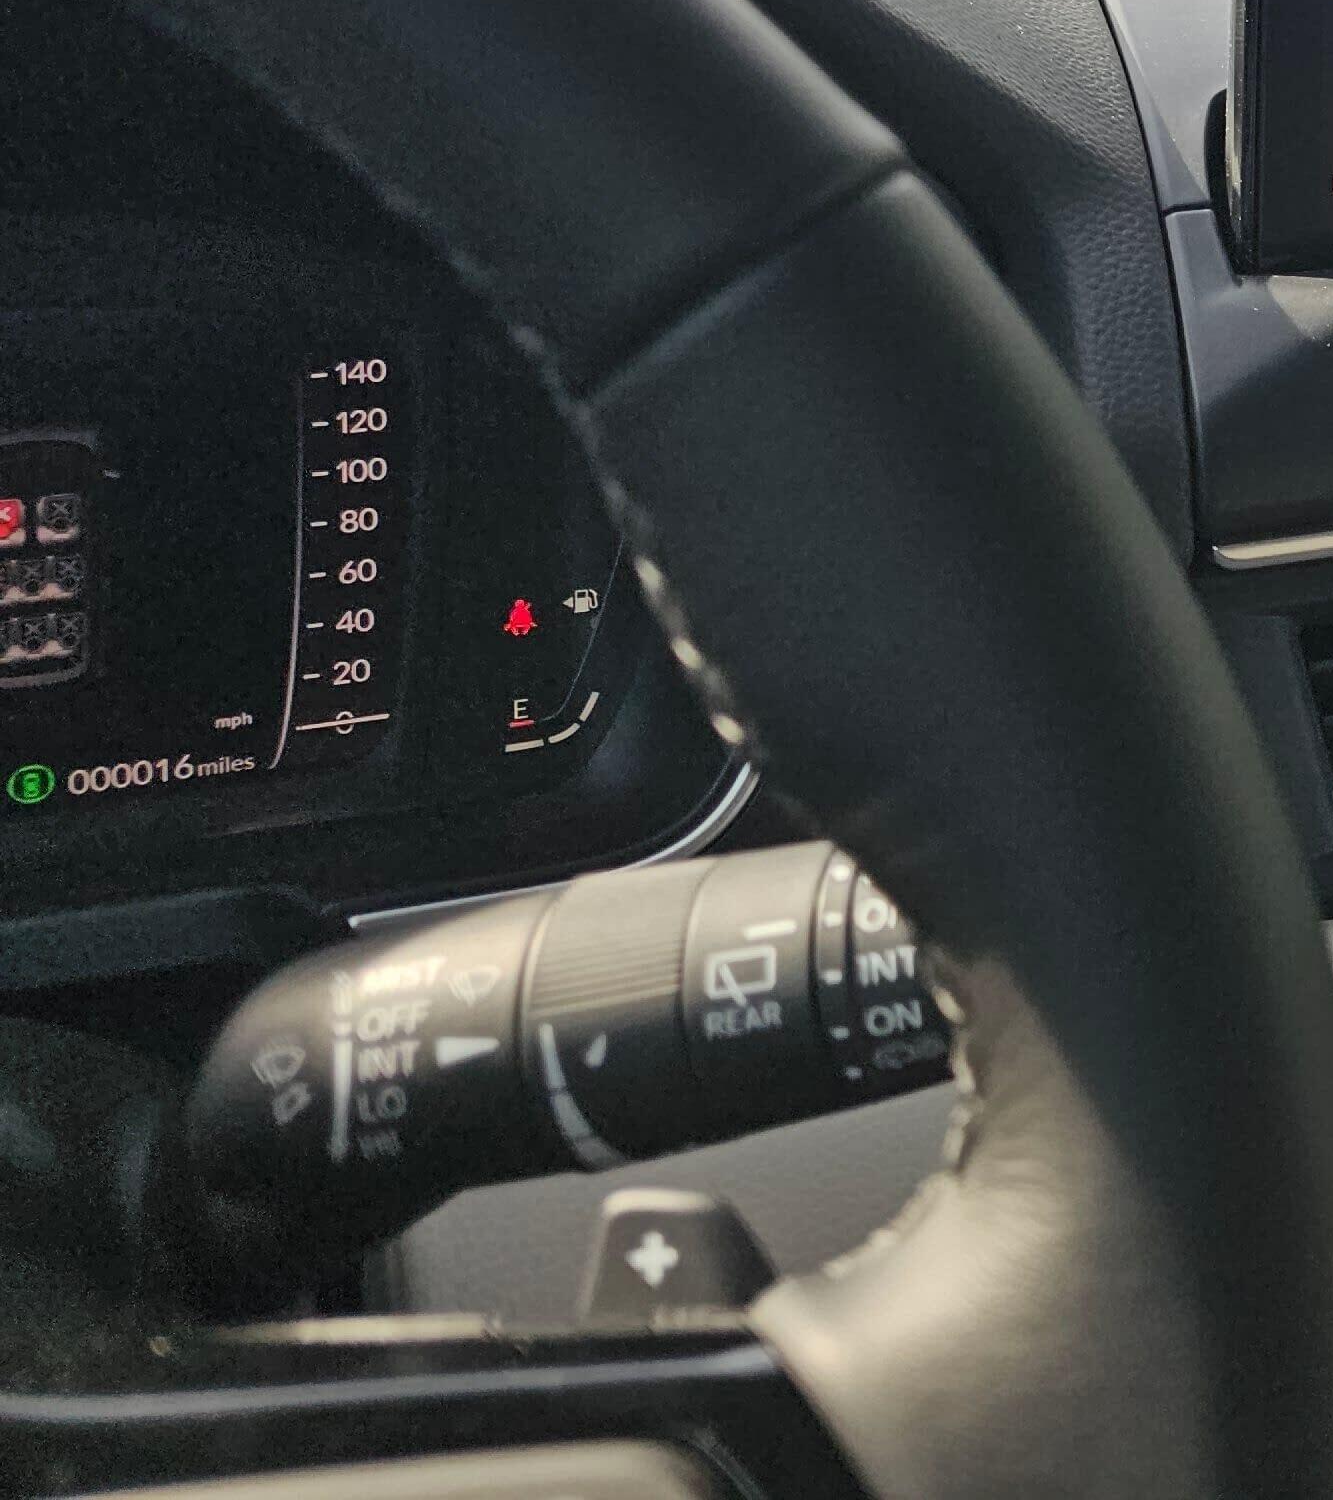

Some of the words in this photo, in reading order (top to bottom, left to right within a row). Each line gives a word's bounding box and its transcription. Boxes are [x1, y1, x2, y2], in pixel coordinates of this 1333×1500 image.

[334, 358, 387, 386] 140
[335, 407, 388, 434] 120
[335, 457, 388, 484] 100
[339, 507, 379, 534] 80
[338, 558, 378, 585] 60
[335, 608, 375, 634] 40
[333, 658, 371, 686] 20
[213, 712, 253, 731] mph
[513, 698, 529, 720] E
[67, 753, 195, 795] 000016
[196, 756, 255, 777] miles
[857, 945, 918, 987] INT
[704, 1001, 782, 1041] REAR
[864, 1000, 923, 1037] ON
